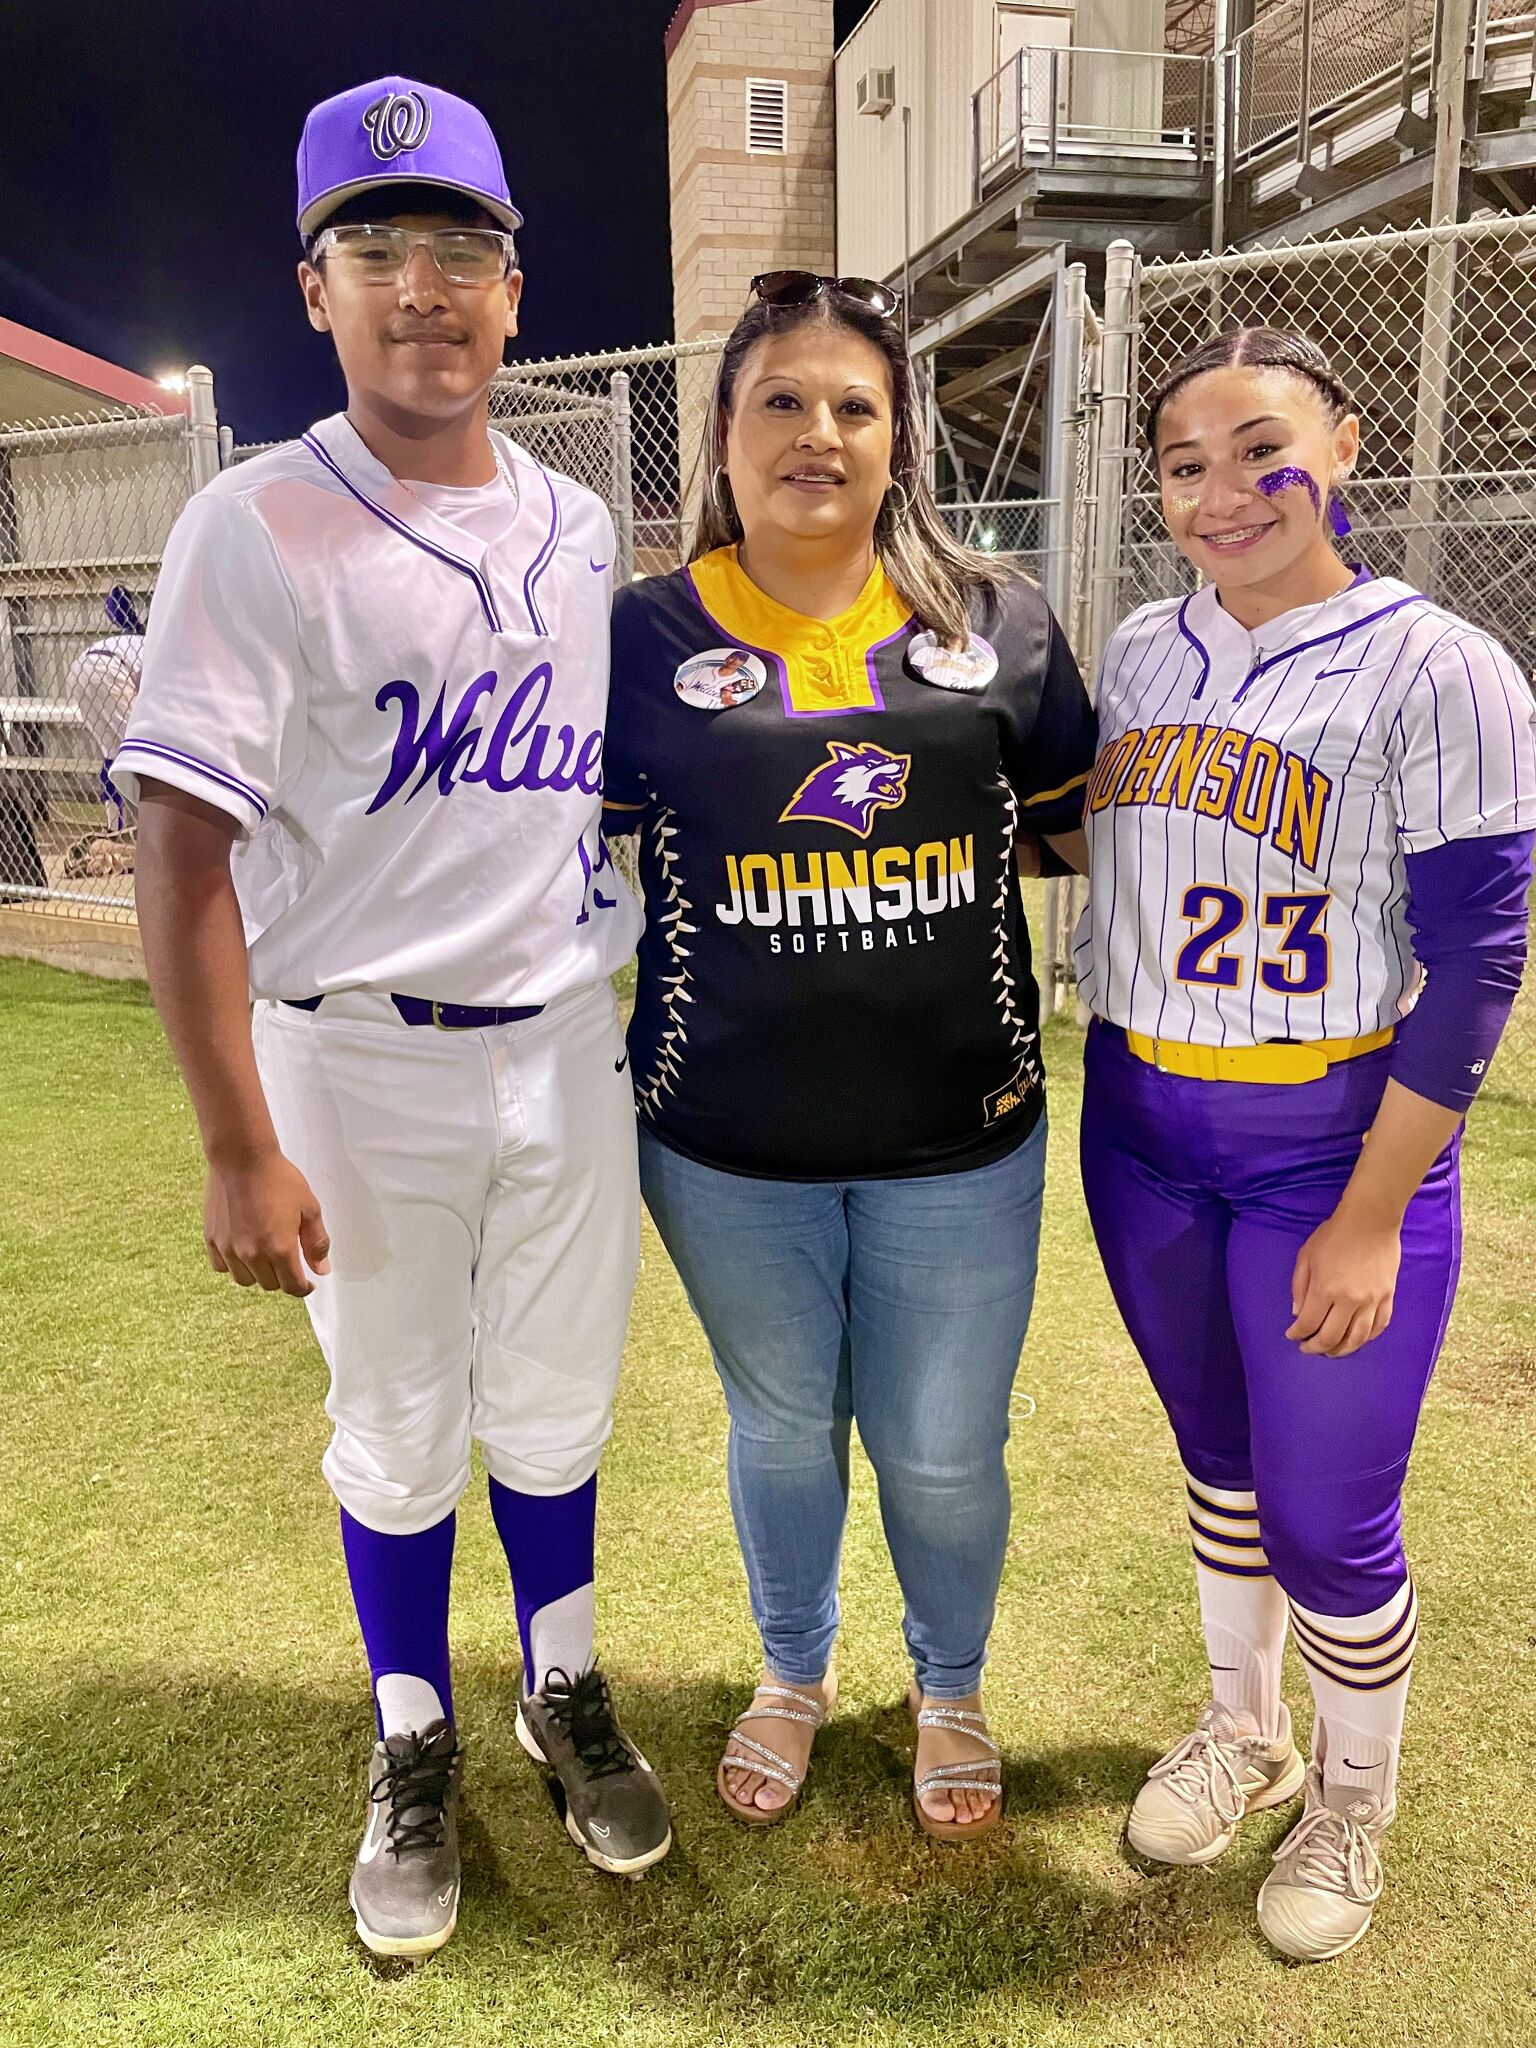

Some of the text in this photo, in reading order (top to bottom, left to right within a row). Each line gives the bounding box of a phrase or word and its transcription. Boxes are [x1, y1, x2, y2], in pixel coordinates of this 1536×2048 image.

[363, 91, 432, 161] W
[365, 661, 604, 816] Wolve
[715, 833, 976, 927] JOHNSON
[769, 921, 936, 954] SOFTBALL
[1173, 881, 1333, 998] 23
